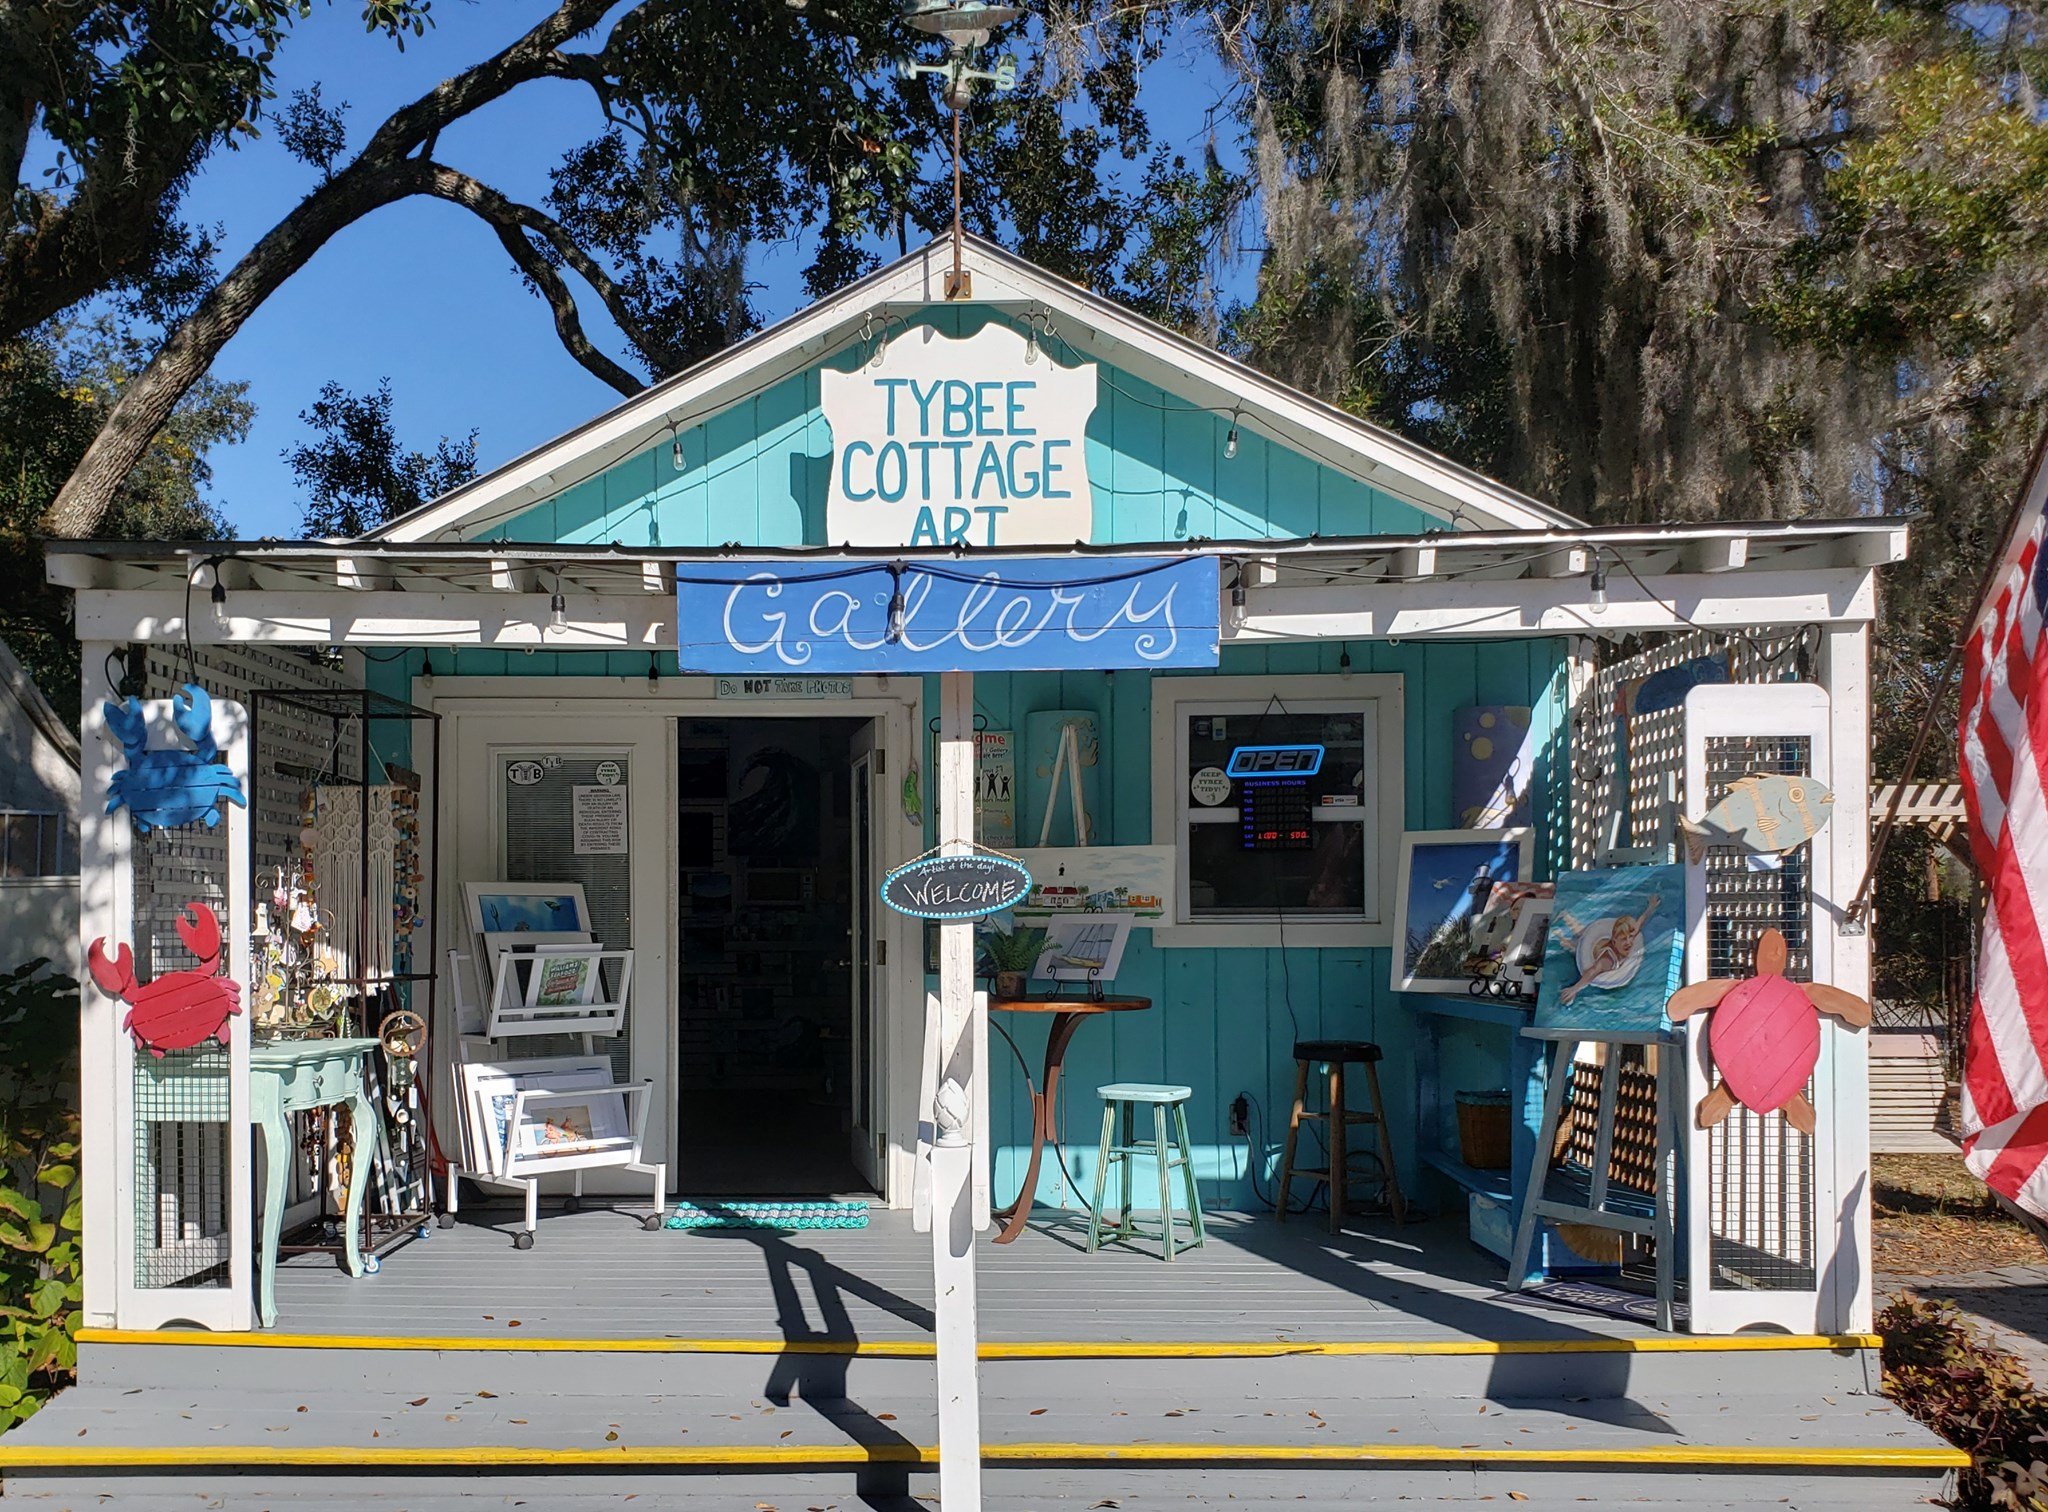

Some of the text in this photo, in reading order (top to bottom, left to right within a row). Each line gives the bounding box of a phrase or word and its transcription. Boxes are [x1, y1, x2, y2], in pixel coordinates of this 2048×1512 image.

[874, 379, 1036, 437] TYBEE
[842, 440, 1071, 503] COTTAGE
[911, 506, 1008, 547] ART
[722, 572, 1178, 665] Gallery
[744, 680, 771, 693] NOT
[807, 680, 850, 693] PHOTOS
[1233, 751, 1319, 772] OPEN
[917, 864, 946, 876] Artist
[960, 861, 974, 869] the
[904, 876, 1016, 906] WELCOME
